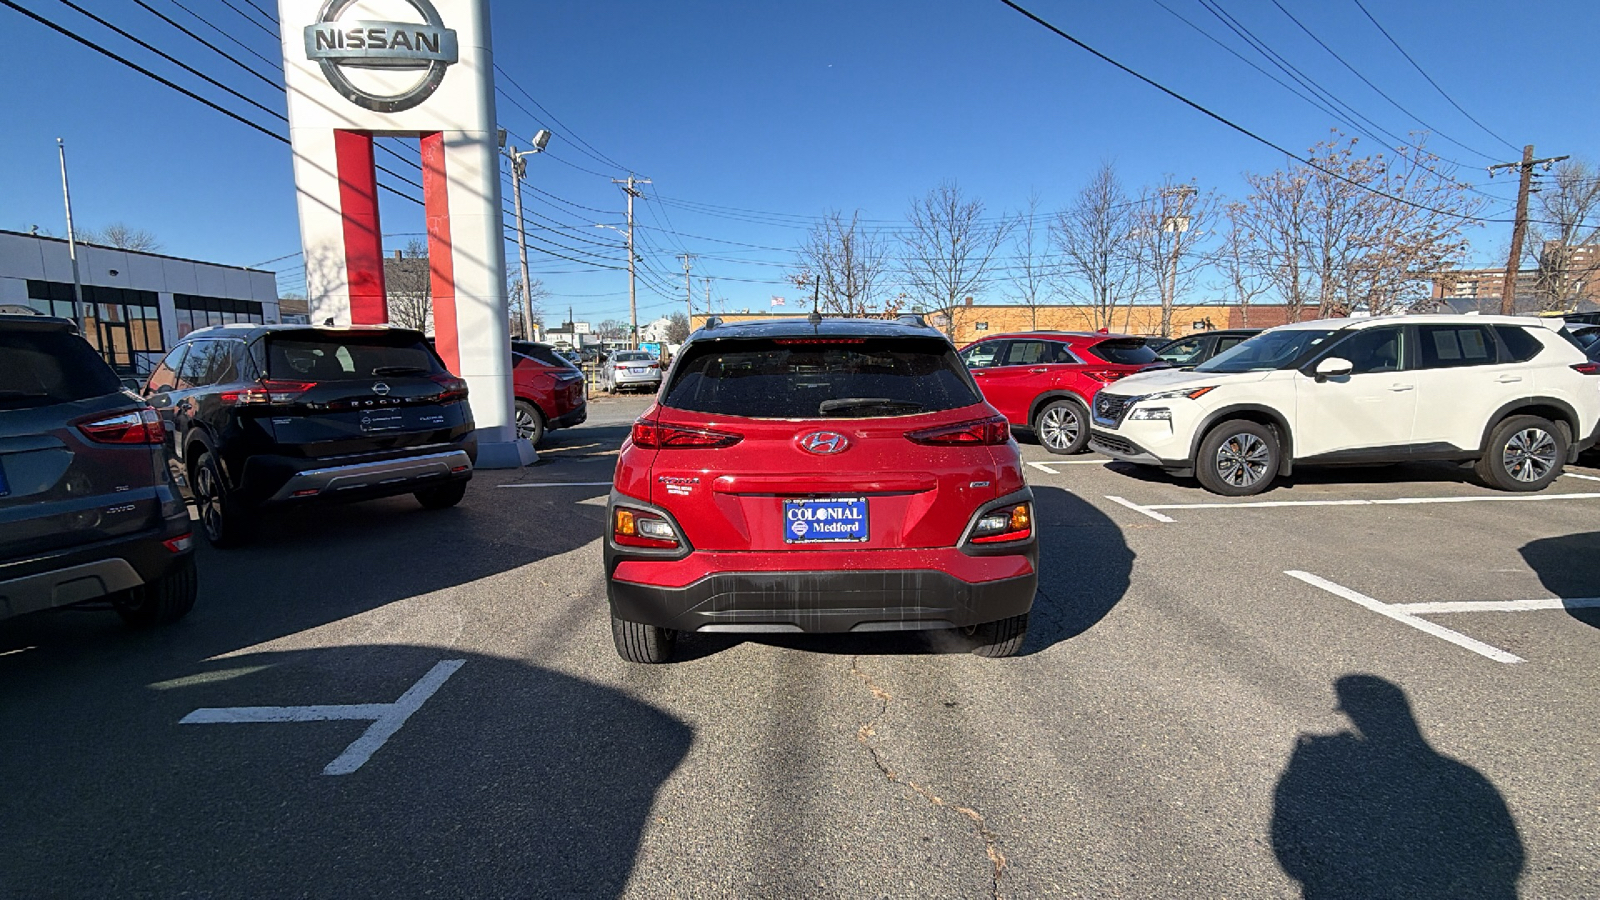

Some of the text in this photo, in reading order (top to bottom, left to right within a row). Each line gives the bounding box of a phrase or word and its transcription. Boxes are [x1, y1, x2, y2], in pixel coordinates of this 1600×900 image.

[315, 27, 440, 54] NISSAN
[658, 476, 700, 484] KONA
[787, 507, 862, 520] COLONIAL
[813, 521, 859, 532] Medford
